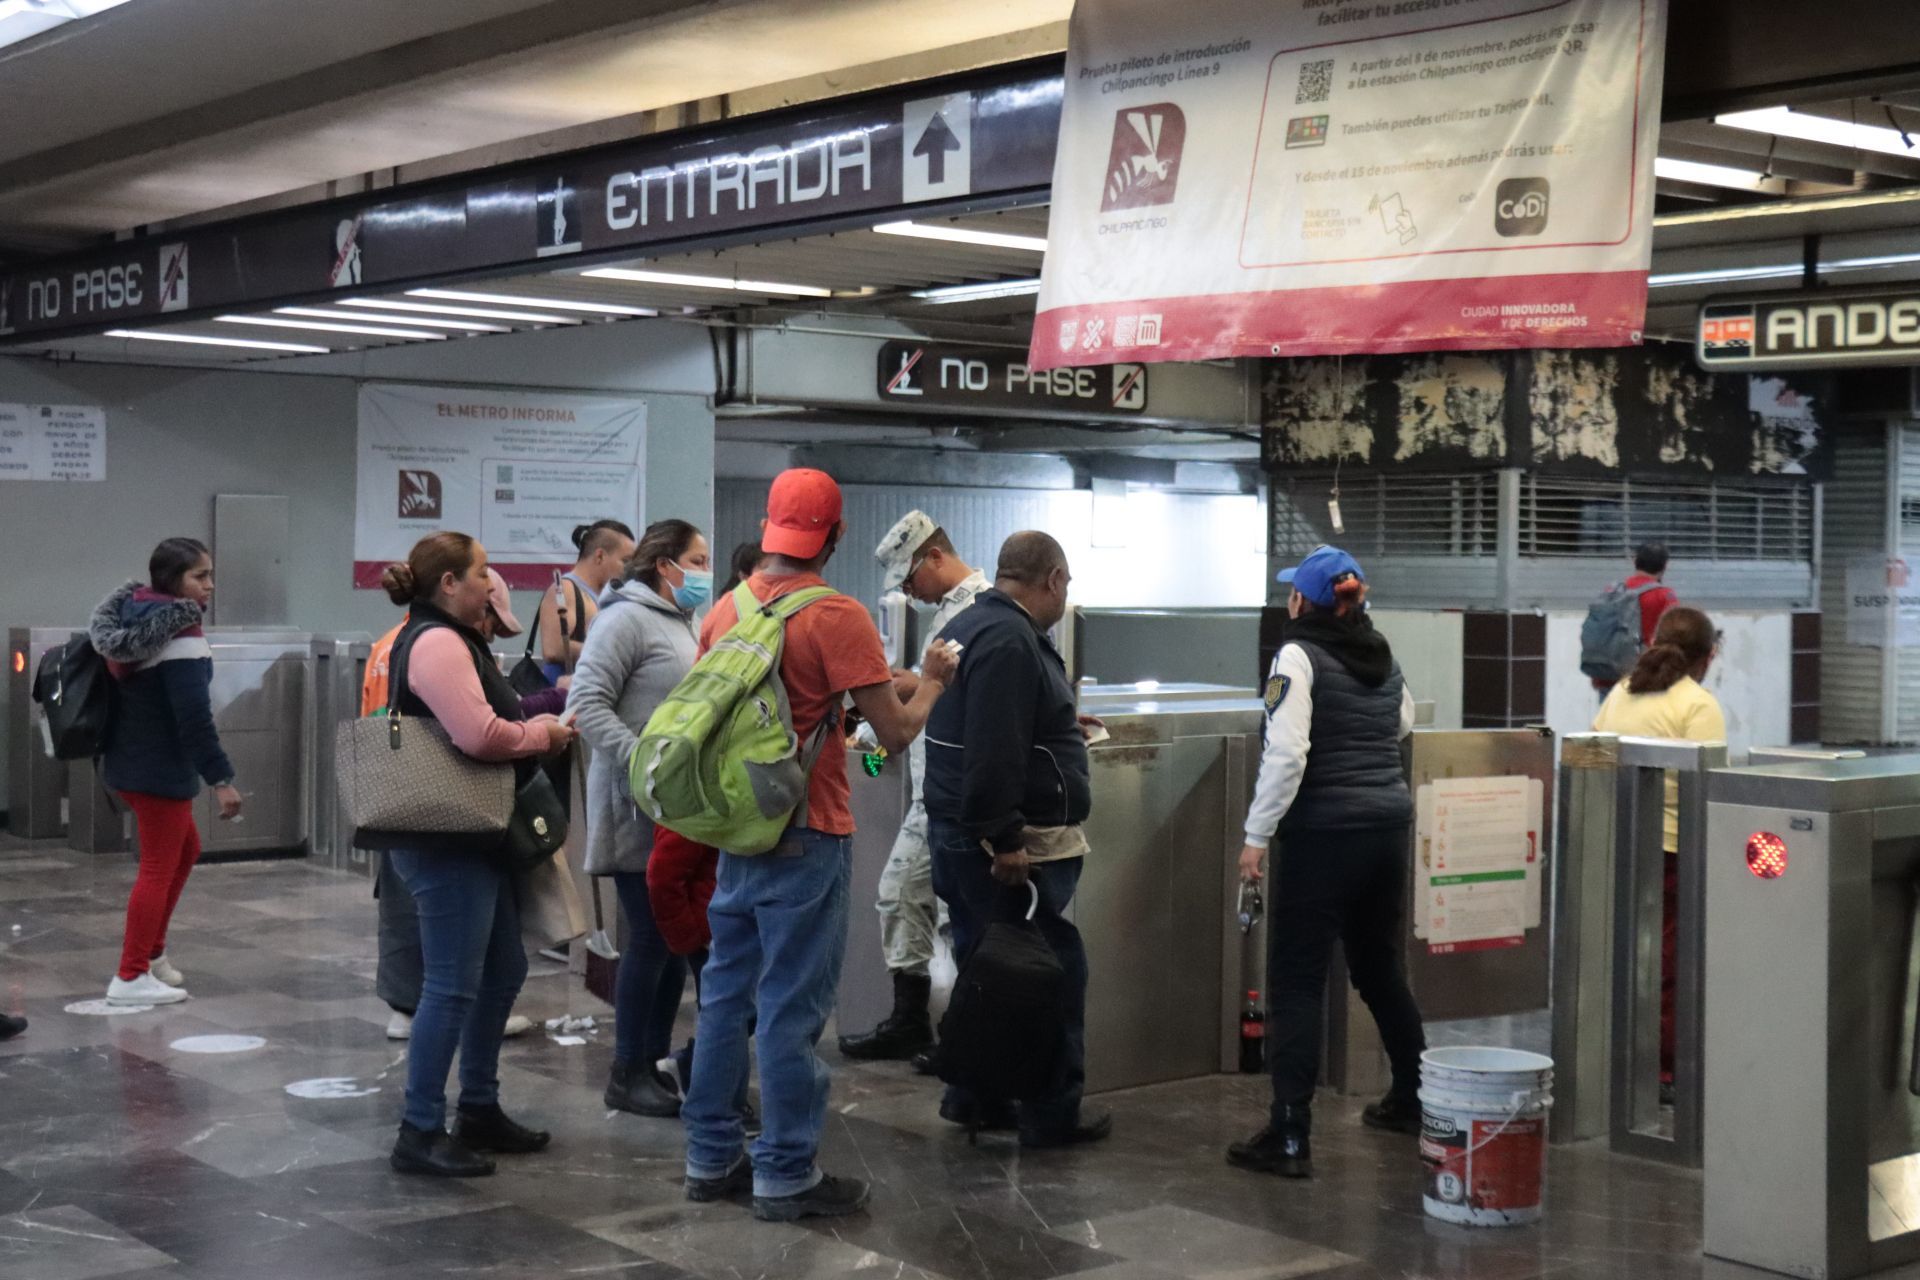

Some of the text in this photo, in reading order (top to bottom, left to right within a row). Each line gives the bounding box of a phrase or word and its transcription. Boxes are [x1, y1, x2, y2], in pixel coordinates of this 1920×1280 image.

[1318, 8, 1372, 26] facilitar
[1376, 5, 1391, 17] tu
[1394, 0, 1439, 14] acceso
[1080, 36, 1252, 80] Prueba piloto de introducción
[1348, 80, 1355, 90] a
[1357, 76, 1368, 89] la
[1370, 70, 1417, 88] estación
[1420, 60, 1494, 80] Chilpancingo
[1496, 54, 1516, 67] con
[1350, 62, 1358, 73] A
[1360, 57, 1392, 74] partir
[1395, 55, 1412, 68] del
[1424, 50, 1439, 62] de
[1102, 62, 1221, 95] Chilpancingo Línea 9
[1342, 118, 1389, 135] También
[1391, 114, 1433, 131] puedes
[1434, 108, 1476, 124] utilizar
[1479, 106, 1491, 118] tu
[606, 133, 872, 231] ENTRADA
[1303, 168, 1337, 183] desde
[1339, 167, 1349, 179] el
[1351, 166, 1365, 178] 15
[1367, 164, 1381, 176] de
[1383, 158, 1444, 175] noviembre
[1447, 149, 1489, 168] además
[29, 263, 143, 320] NO PASE
[1461, 303, 1576, 318] CIUDAD INNOVADORA
[1501, 316, 1588, 329] Y DE DERECHOS
[941, 358, 1097, 398] NO PASE
[437, 403, 577, 423] EL METRO INFORMA
